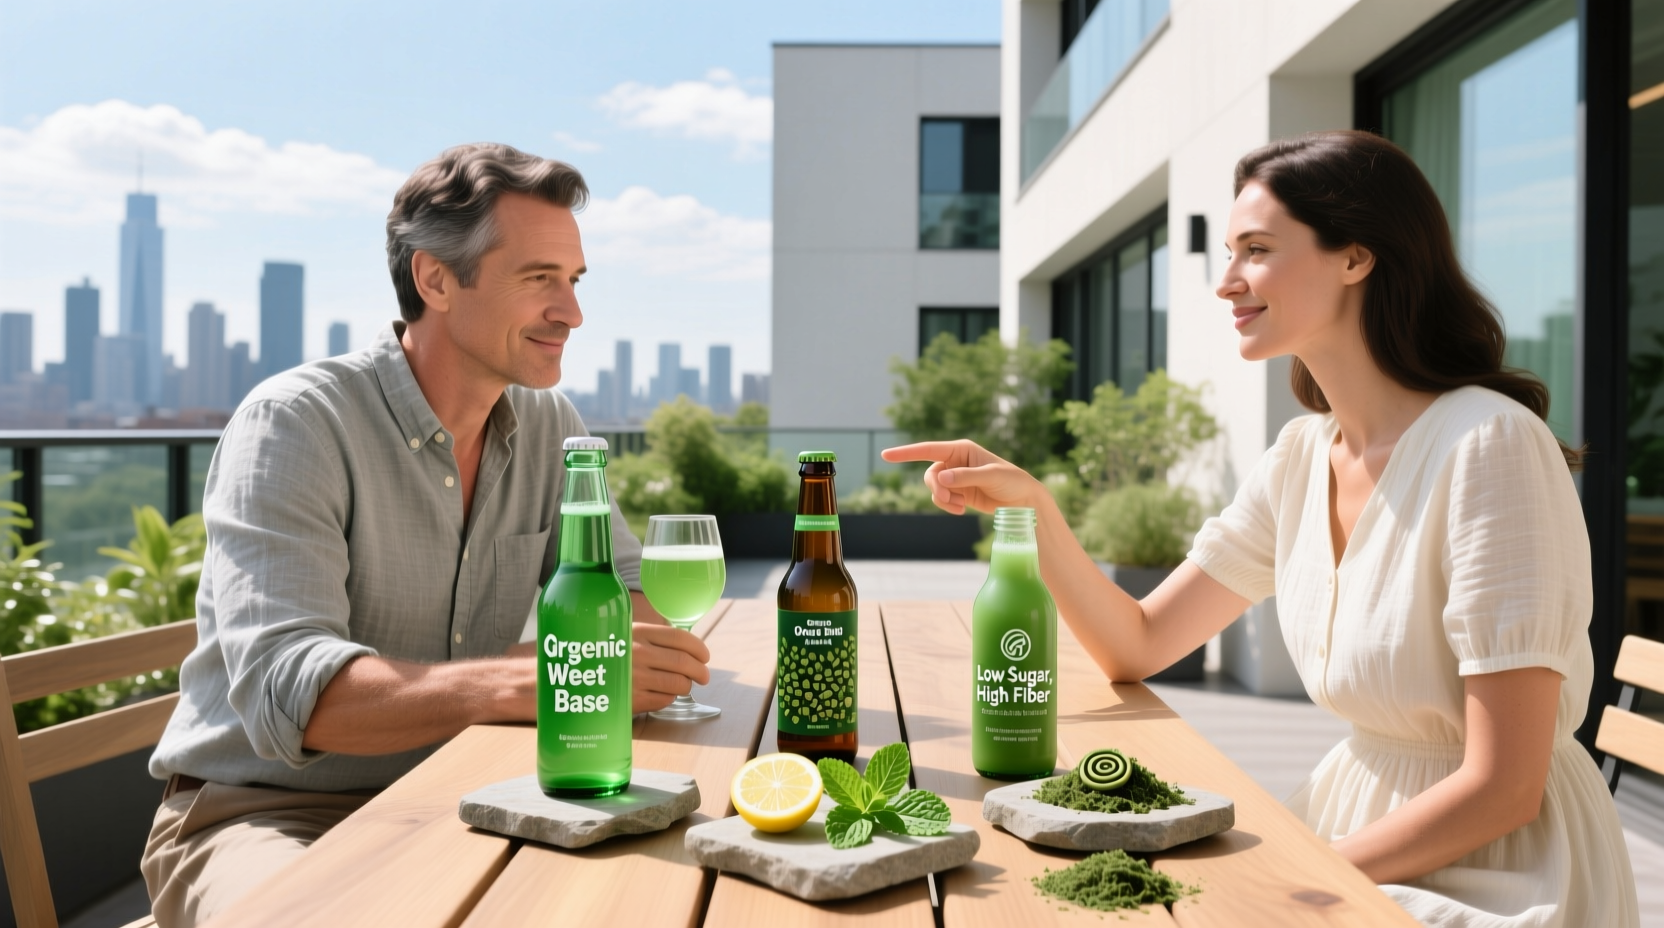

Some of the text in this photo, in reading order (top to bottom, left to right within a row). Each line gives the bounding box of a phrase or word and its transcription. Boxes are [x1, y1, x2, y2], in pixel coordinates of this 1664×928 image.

[547, 662, 606, 686] Weet
[977, 664, 1053, 687] Low Sugar,
[554, 689, 609, 713] Base
[976, 684, 1009, 707] High
